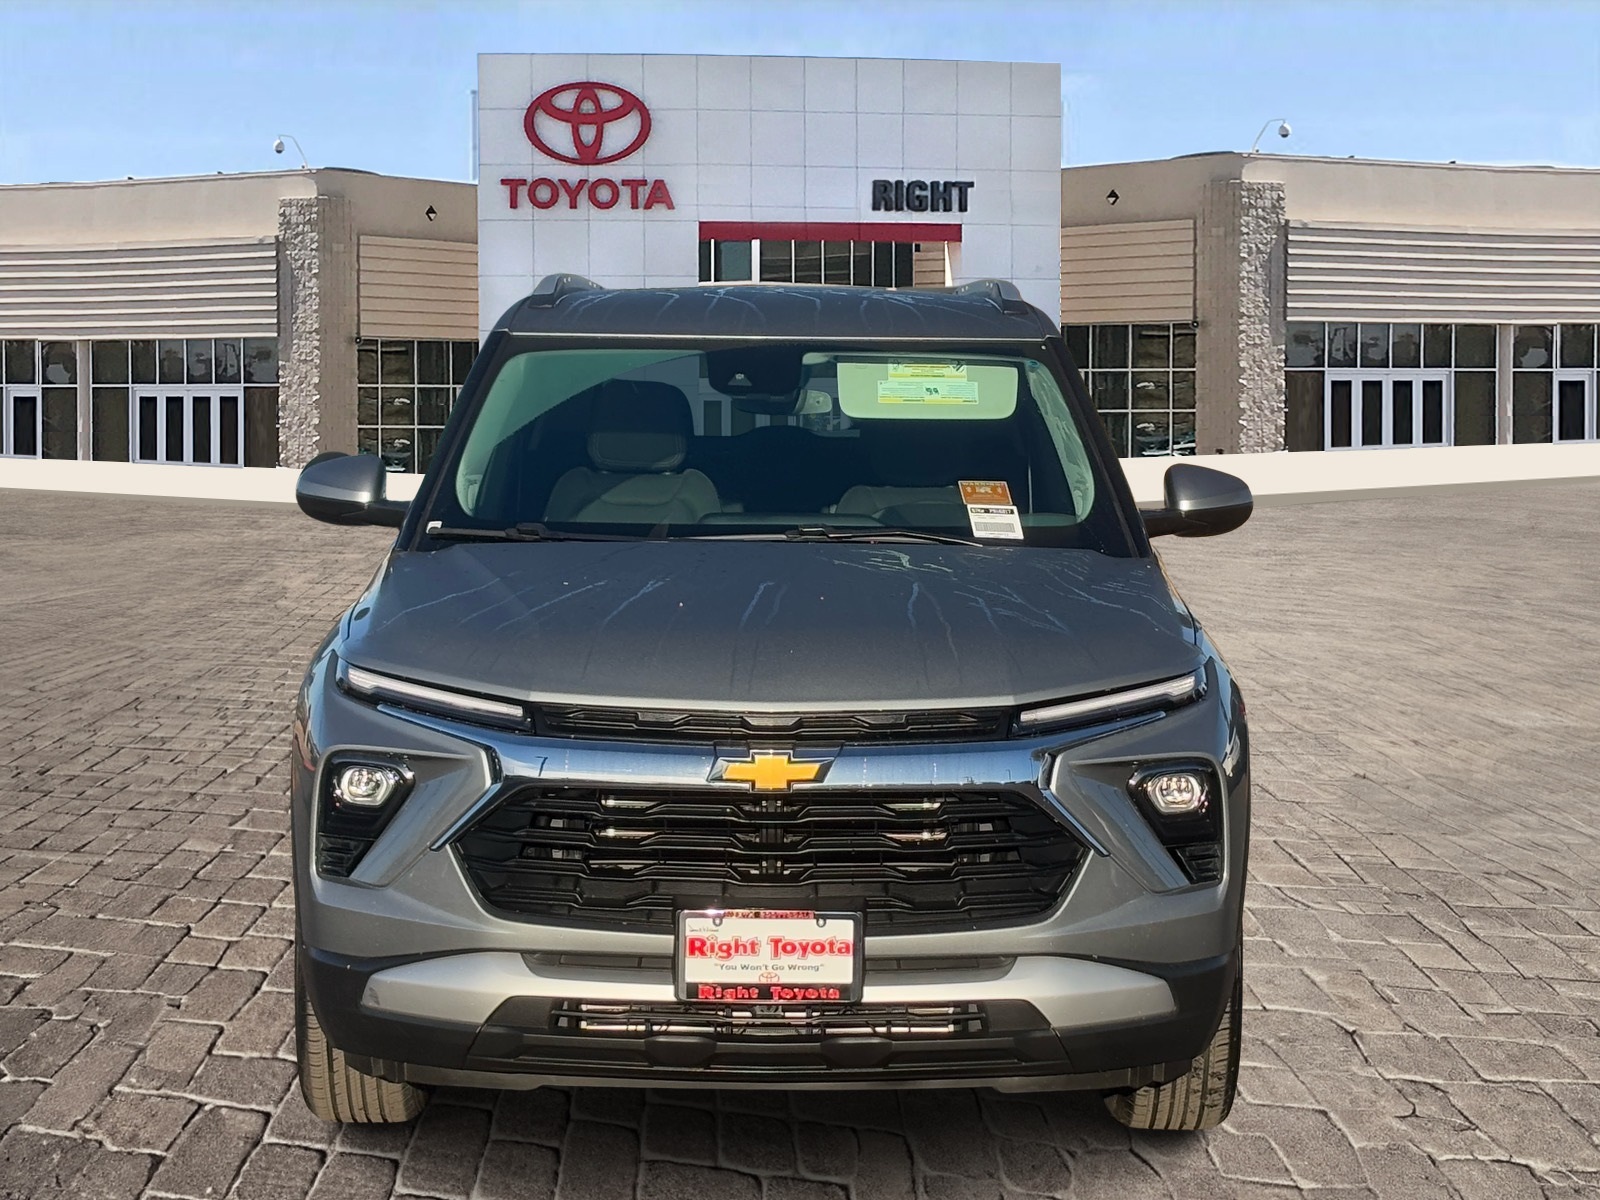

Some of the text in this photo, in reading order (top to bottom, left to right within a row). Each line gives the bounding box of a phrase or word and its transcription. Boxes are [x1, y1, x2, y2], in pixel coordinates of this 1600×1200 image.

[500, 178, 675, 210] TOYOTA
[872, 180, 975, 212] RIGHT
[686, 936, 853, 960] Right Toyota
[740, 963, 769, 971] Won't
[771, 963, 785, 971] Go
[698, 984, 840, 1000] Right Toyota
